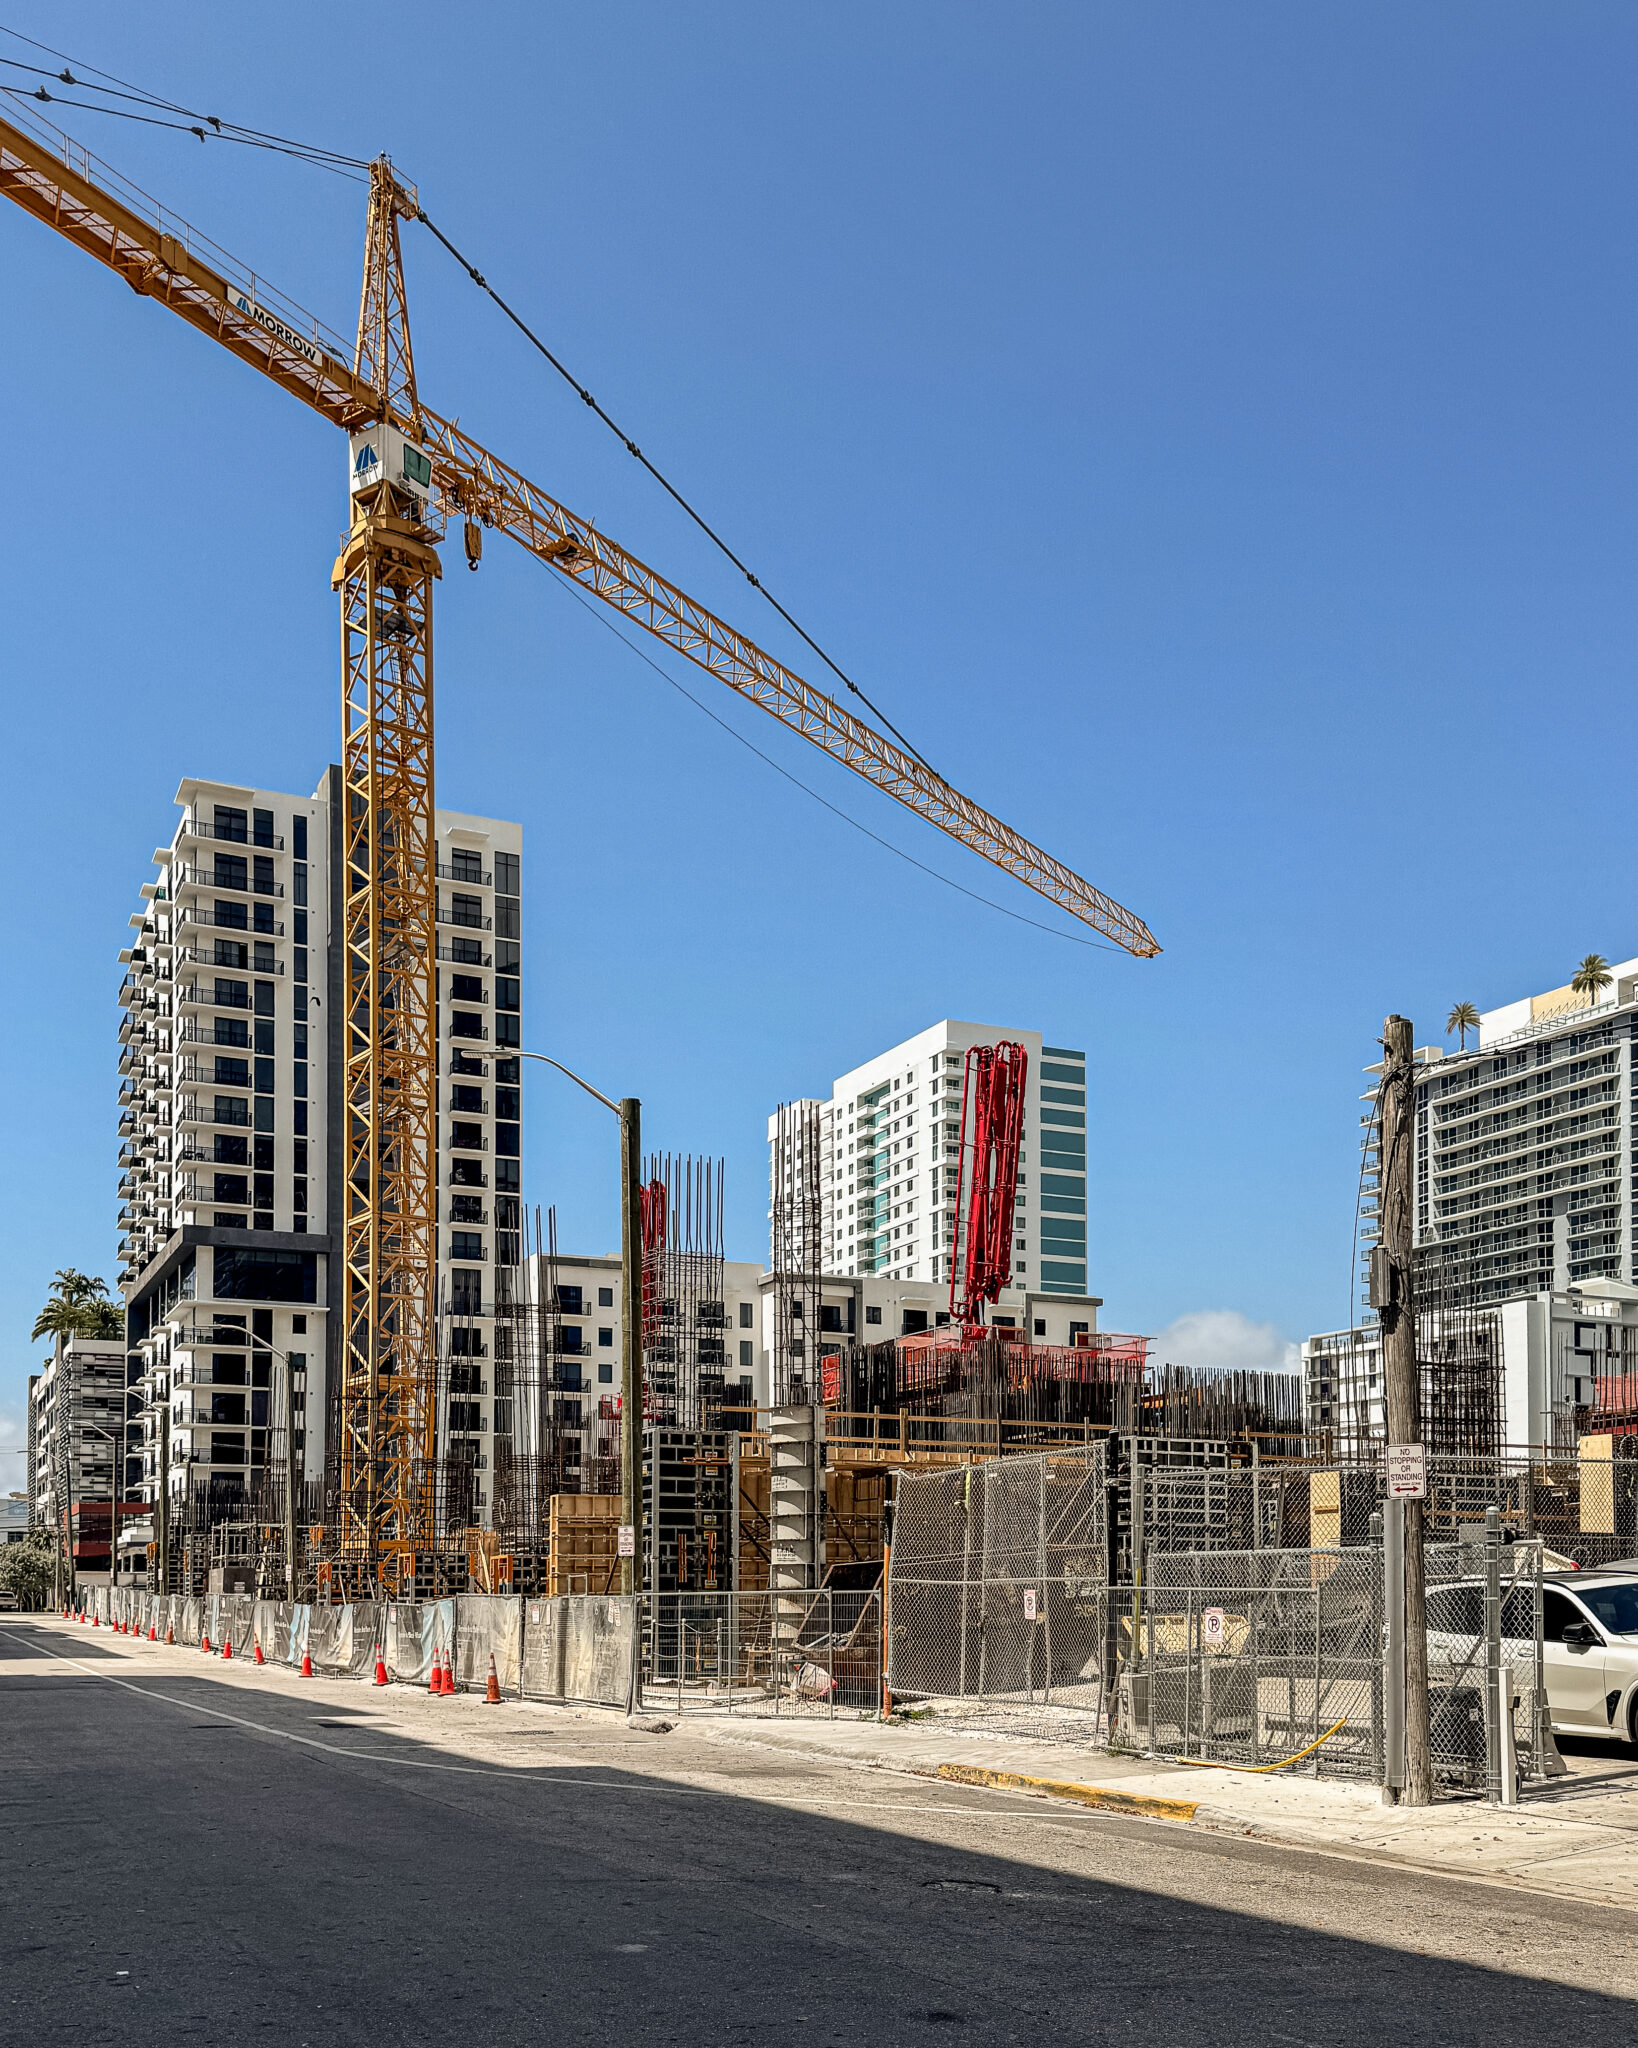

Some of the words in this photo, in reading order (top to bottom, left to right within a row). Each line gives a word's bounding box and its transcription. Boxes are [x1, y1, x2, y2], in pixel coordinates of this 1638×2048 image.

[253, 307, 317, 361] MORROW
[1390, 1456, 1422, 1464] STOPPING
[1391, 1473, 1422, 1481] STANDING
